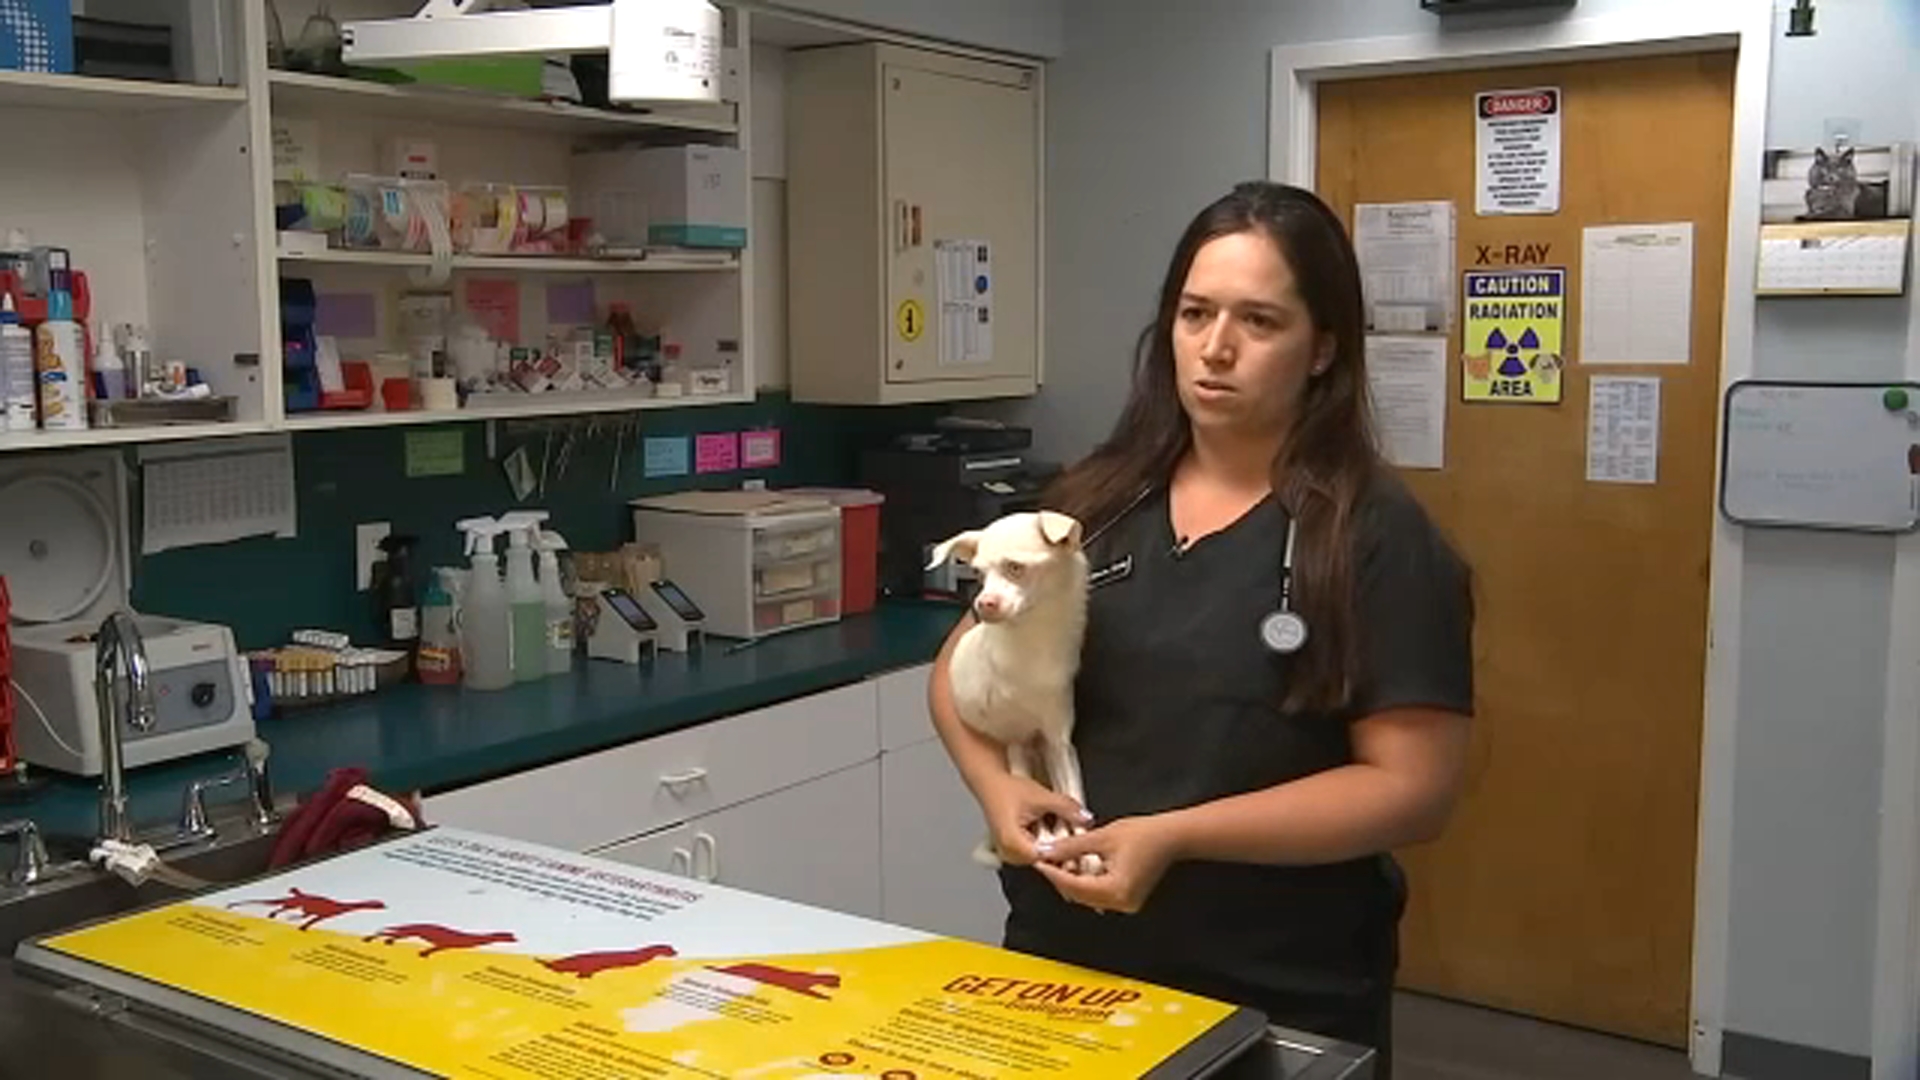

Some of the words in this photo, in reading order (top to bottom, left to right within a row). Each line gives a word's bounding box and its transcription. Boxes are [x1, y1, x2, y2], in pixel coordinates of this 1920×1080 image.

[1492, 97, 1543, 112] DANGER
[1475, 244, 1551, 265] X-RAY
[1475, 277, 1549, 294] CAUTION
[1470, 303, 1558, 319] RADIATION
[1489, 380, 1534, 396] AREA
[942, 974, 1029, 997] GET
[1017, 983, 1085, 1004] ON
[1079, 989, 1142, 1008] UP
